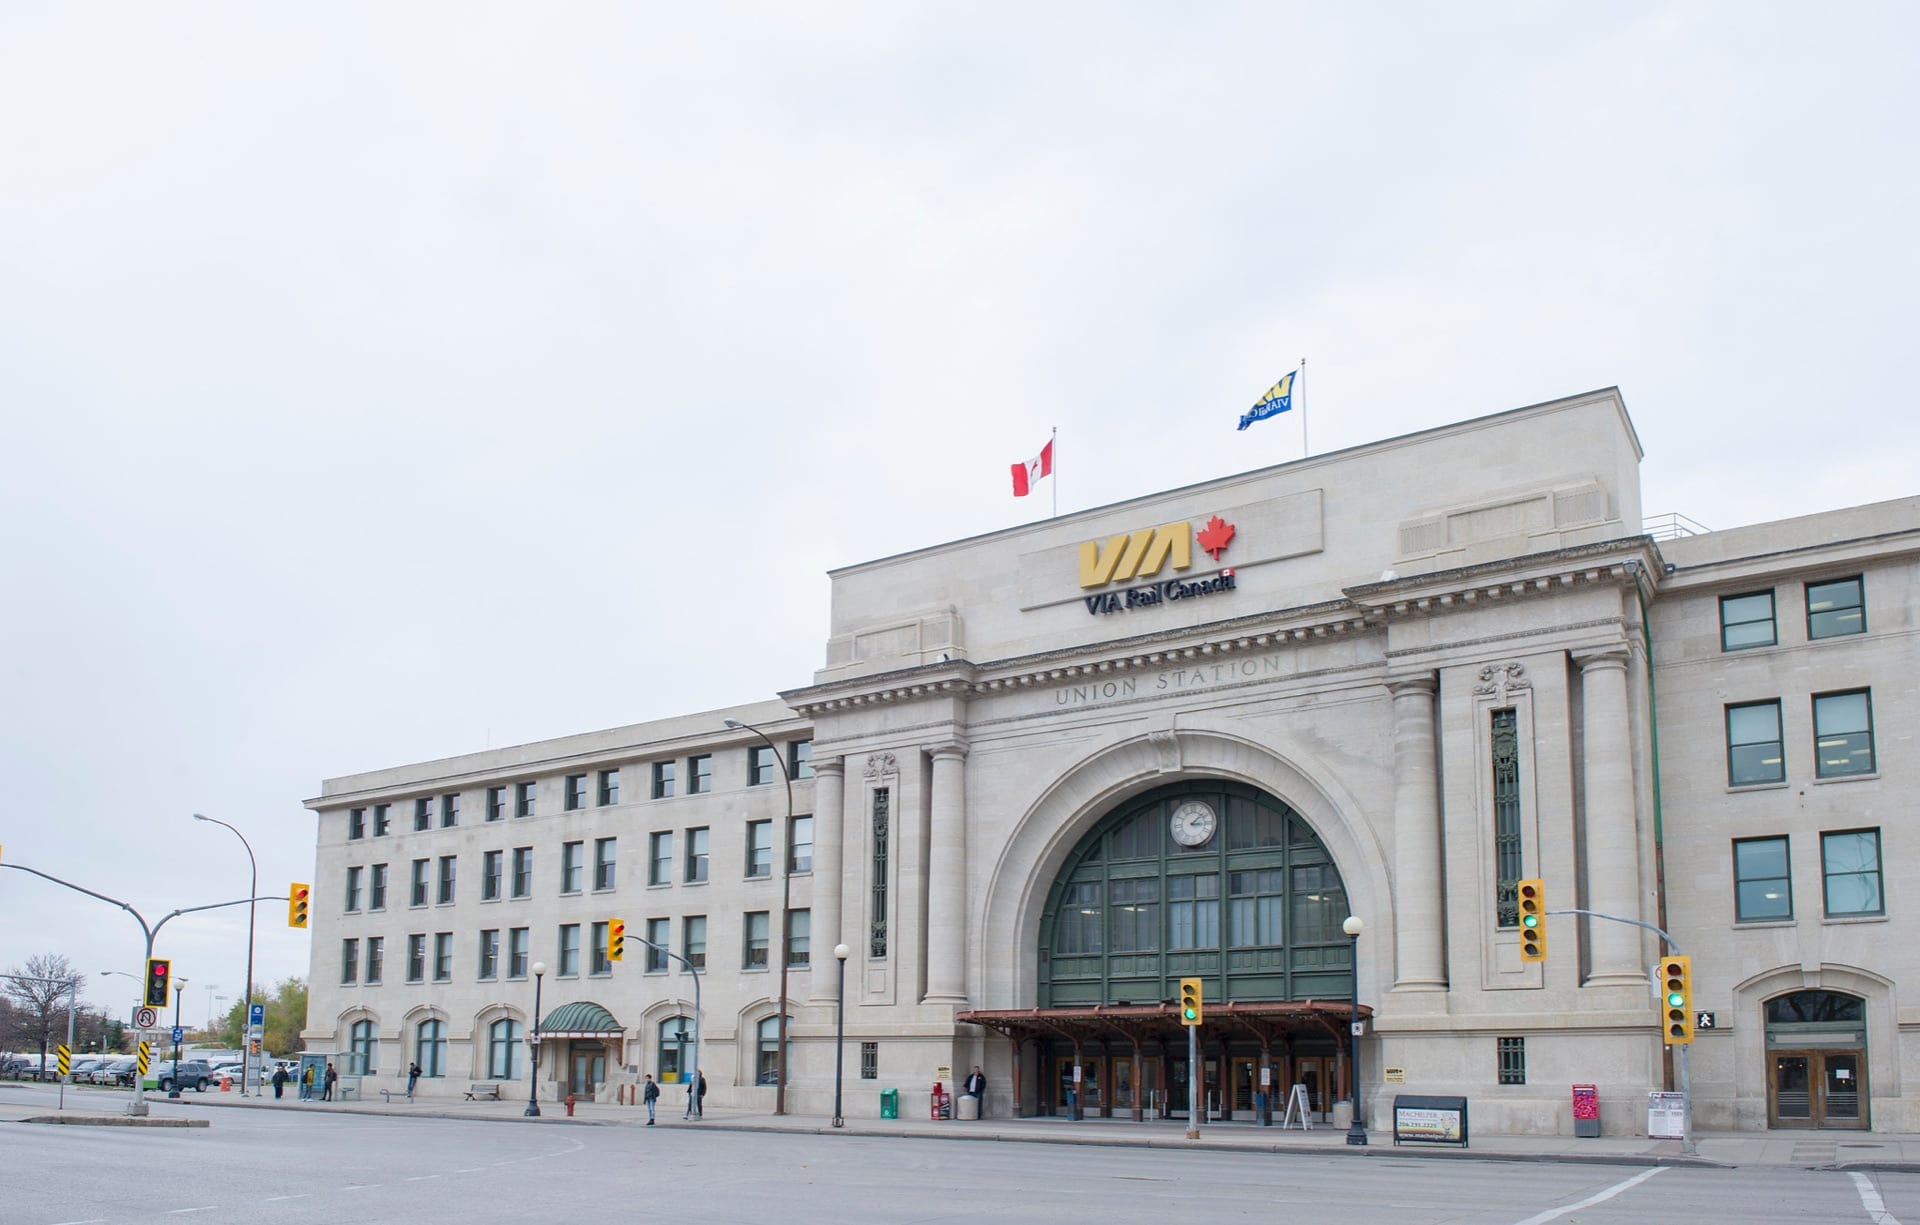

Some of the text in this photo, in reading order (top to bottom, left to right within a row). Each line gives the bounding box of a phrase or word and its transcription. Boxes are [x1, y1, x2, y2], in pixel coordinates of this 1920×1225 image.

[1079, 521, 1191, 589] VIA
[1085, 570, 1237, 616] VIA Rail Canada
[1055, 656, 1279, 705] UNION STATION
